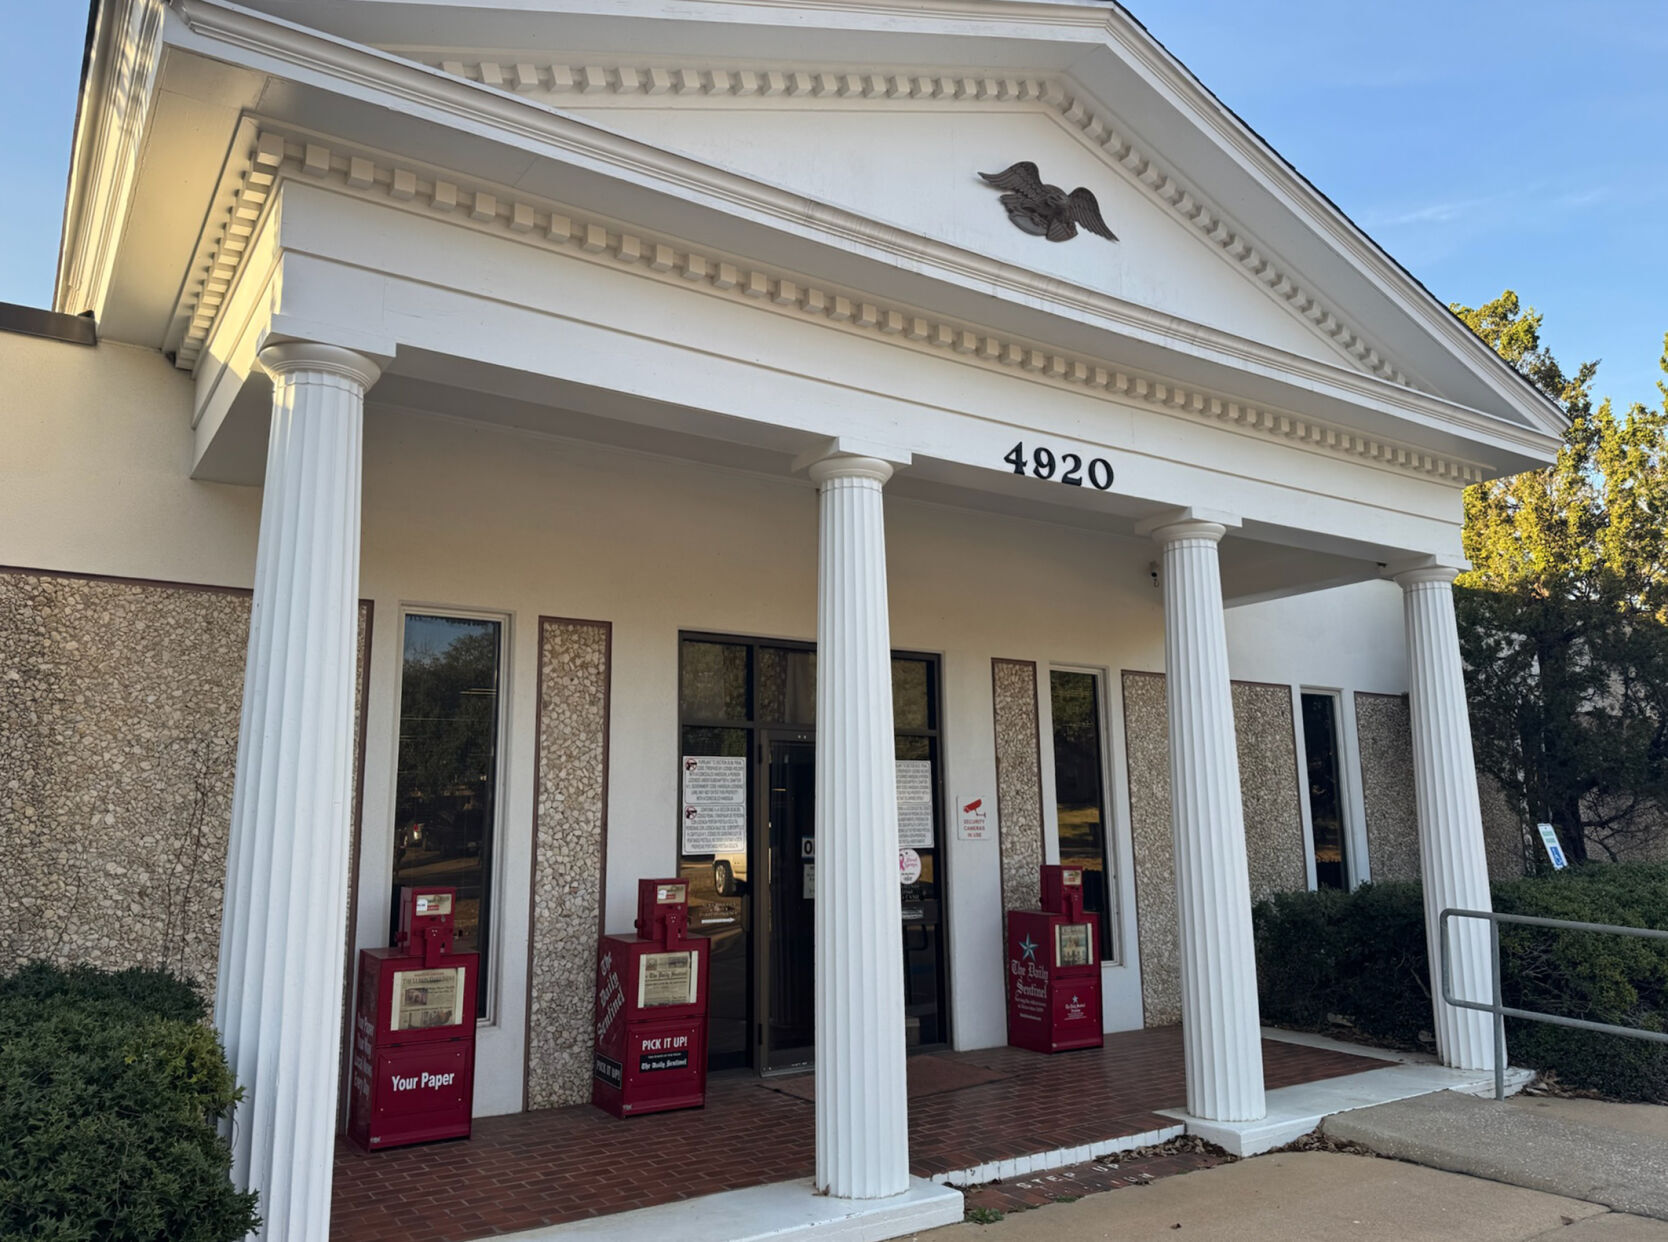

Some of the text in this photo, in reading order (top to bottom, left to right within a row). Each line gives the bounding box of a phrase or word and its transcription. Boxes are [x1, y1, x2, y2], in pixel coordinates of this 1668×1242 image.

[1003, 440, 1115, 491] 4920
[1011, 959, 1049, 981] The Daily
[1015, 975, 1048, 999] Sentinel
[642, 1036, 688, 1051] PICK IT UP!
[391, 1071, 455, 1092] Your Paper
[1015, 1162, 1119, 1189] STEP UP
